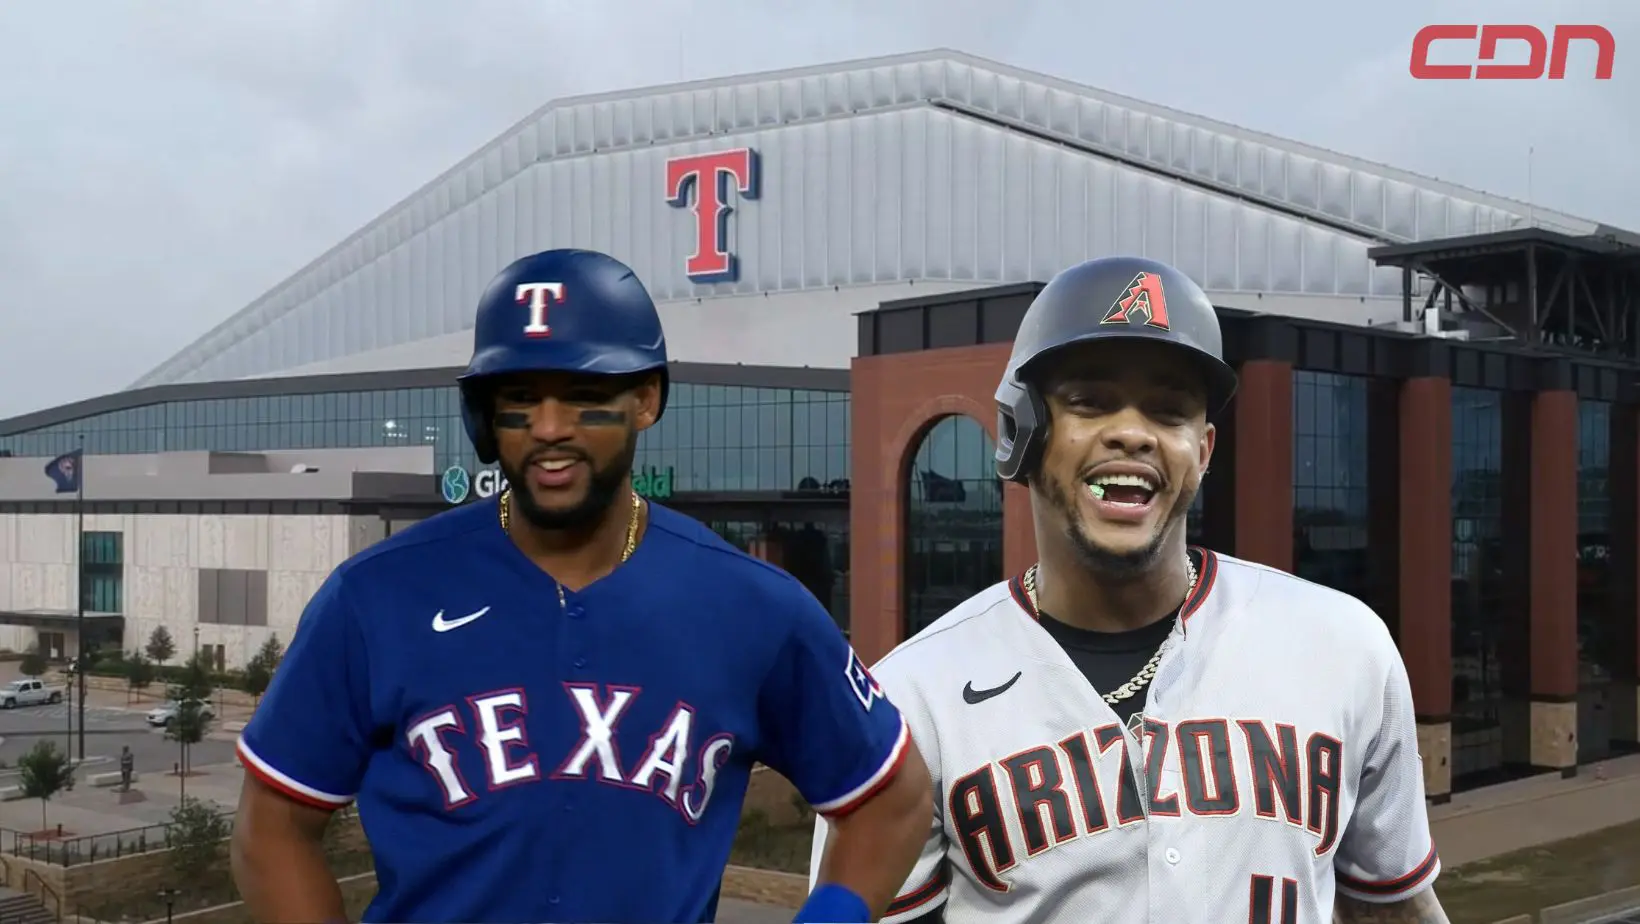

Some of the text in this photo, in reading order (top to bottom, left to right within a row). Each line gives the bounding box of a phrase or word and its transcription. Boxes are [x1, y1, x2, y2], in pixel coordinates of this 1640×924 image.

[665, 147, 761, 283] T
[515, 282, 566, 337] T
[405, 682, 735, 825] TEXAS
[949, 717, 1344, 893] ARIZONA
